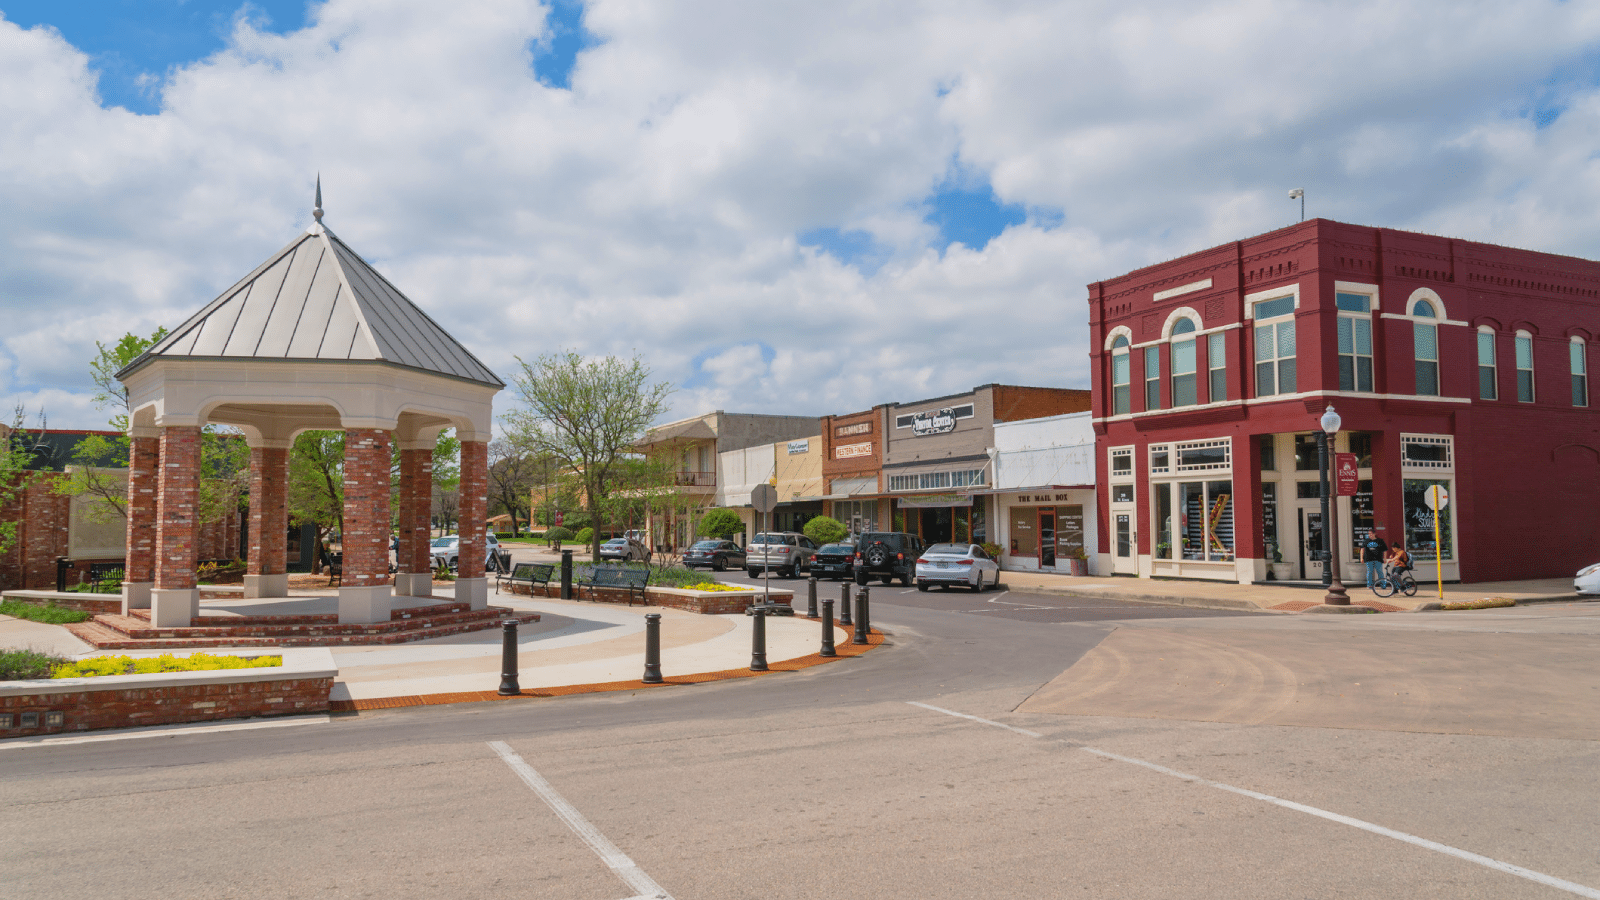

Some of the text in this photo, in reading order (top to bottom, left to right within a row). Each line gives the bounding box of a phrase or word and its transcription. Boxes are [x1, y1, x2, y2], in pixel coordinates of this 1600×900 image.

[836, 443, 871, 457] WESTERN FINANCE
[1055, 493, 1068, 501] BOX
